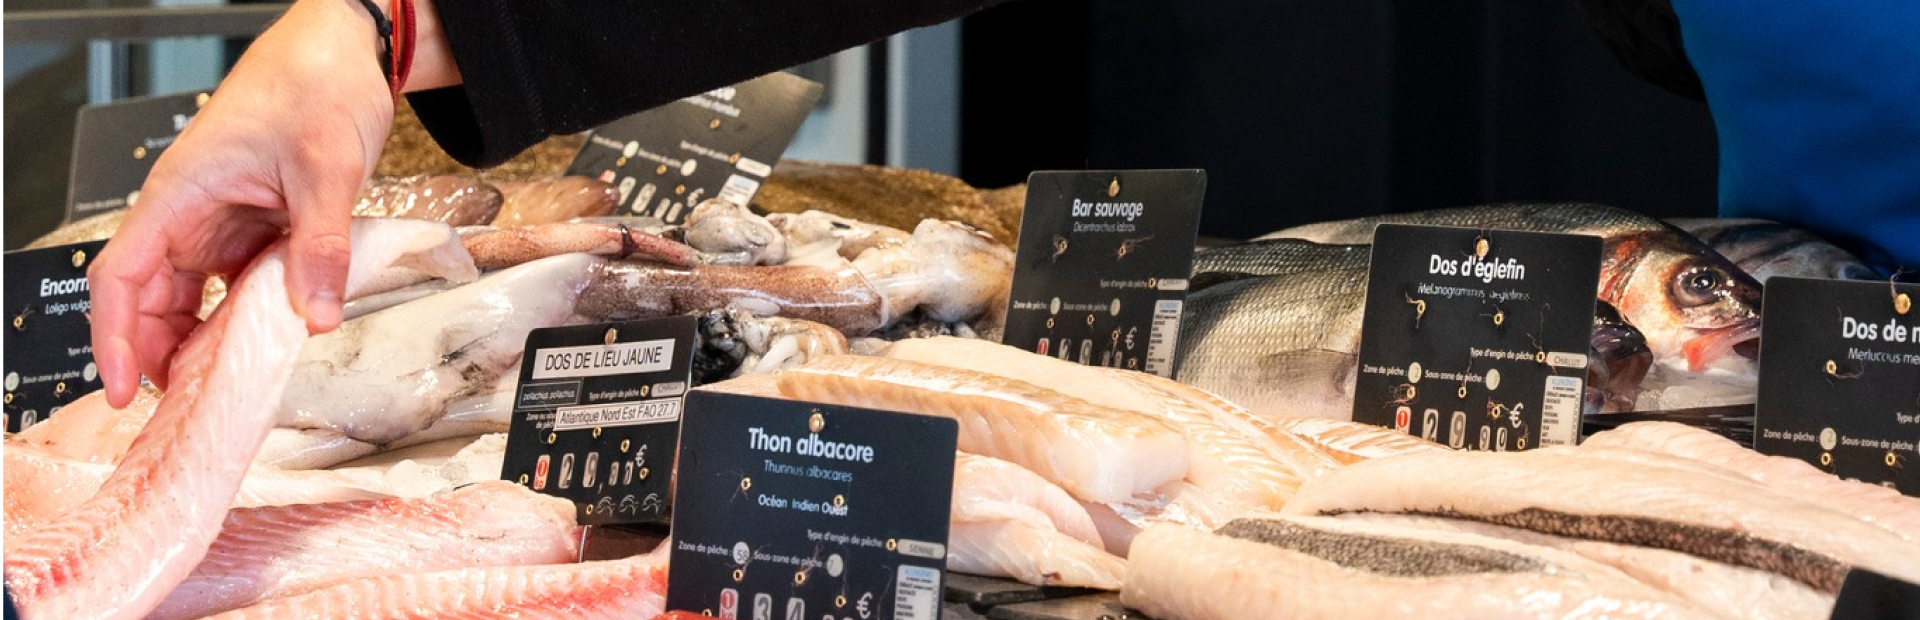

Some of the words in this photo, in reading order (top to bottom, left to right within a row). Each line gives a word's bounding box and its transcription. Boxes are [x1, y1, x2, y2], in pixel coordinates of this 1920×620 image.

[1071, 198, 1092, 218] Bar
[1094, 200, 1144, 221] sauvage
[1429, 254, 1458, 276] Dos
[1461, 255, 1525, 283] d'églefin
[40, 277, 90, 298] Encorn
[45, 302, 69, 316] Loligo
[70, 299, 91, 313] vulga
[1842, 316, 1878, 341] Dos
[1882, 317, 1908, 343] de
[545, 352, 571, 371] DOS
[574, 351, 591, 369] DE
[593, 349, 620, 368] LIEU
[622, 346, 664, 367] JAUNE
[1469, 347, 1484, 358] Type
[1484, 348, 1506, 359] d'engin
[1506, 350, 1515, 359] de
[1515, 350, 1534, 361] pêche
[1554, 355, 1581, 366] CHALUT
[1848, 347, 1901, 364] Merluccius
[1363, 364, 1378, 374] Zone
[1378, 365, 1387, 374] de
[1386, 366, 1405, 376] pêche
[1424, 369, 1455, 381] Sous-zone
[1455, 373, 1464, 381] de
[1464, 373, 1482, 384] pêche
[560, 410, 600, 425] Atlantique
[600, 408, 620, 421] Nord
[621, 406, 637, 420] Est
[637, 403, 657, 418] FAO
[657, 402, 676, 417] 27.7
[1509, 402, 1524, 429] €
[1896, 411, 1913, 424] Type
[543, 420, 554, 430] pêch
[748, 426, 791, 454] Thon
[796, 433, 875, 463] albacore
[1763, 428, 1782, 439] Zone
[1783, 429, 1793, 440] de
[1793, 431, 1815, 443] pêche
[1841, 435, 1879, 448] Sous-zone
[1880, 439, 1889, 449] de
[1891, 440, 1914, 452] pêche
[635, 444, 648, 467] €
[763, 459, 804, 477] Thunnus
[805, 462, 854, 483] albacares
[758, 494, 788, 508] Océan
[791, 499, 820, 512] Indien
[821, 501, 848, 517] Ouest
[678, 540, 696, 551] Zone
[697, 543, 706, 552] de
[707, 544, 728, 556] pêche
[807, 528, 823, 541] Type
[823, 531, 850, 545] d'engin
[850, 534, 860, 544] de
[860, 536, 883, 548] pêche
[753, 549, 790, 564] Sous-zone
[790, 555, 800, 565] de
[801, 556, 823, 568] pêche
[856, 591, 873, 620] €
